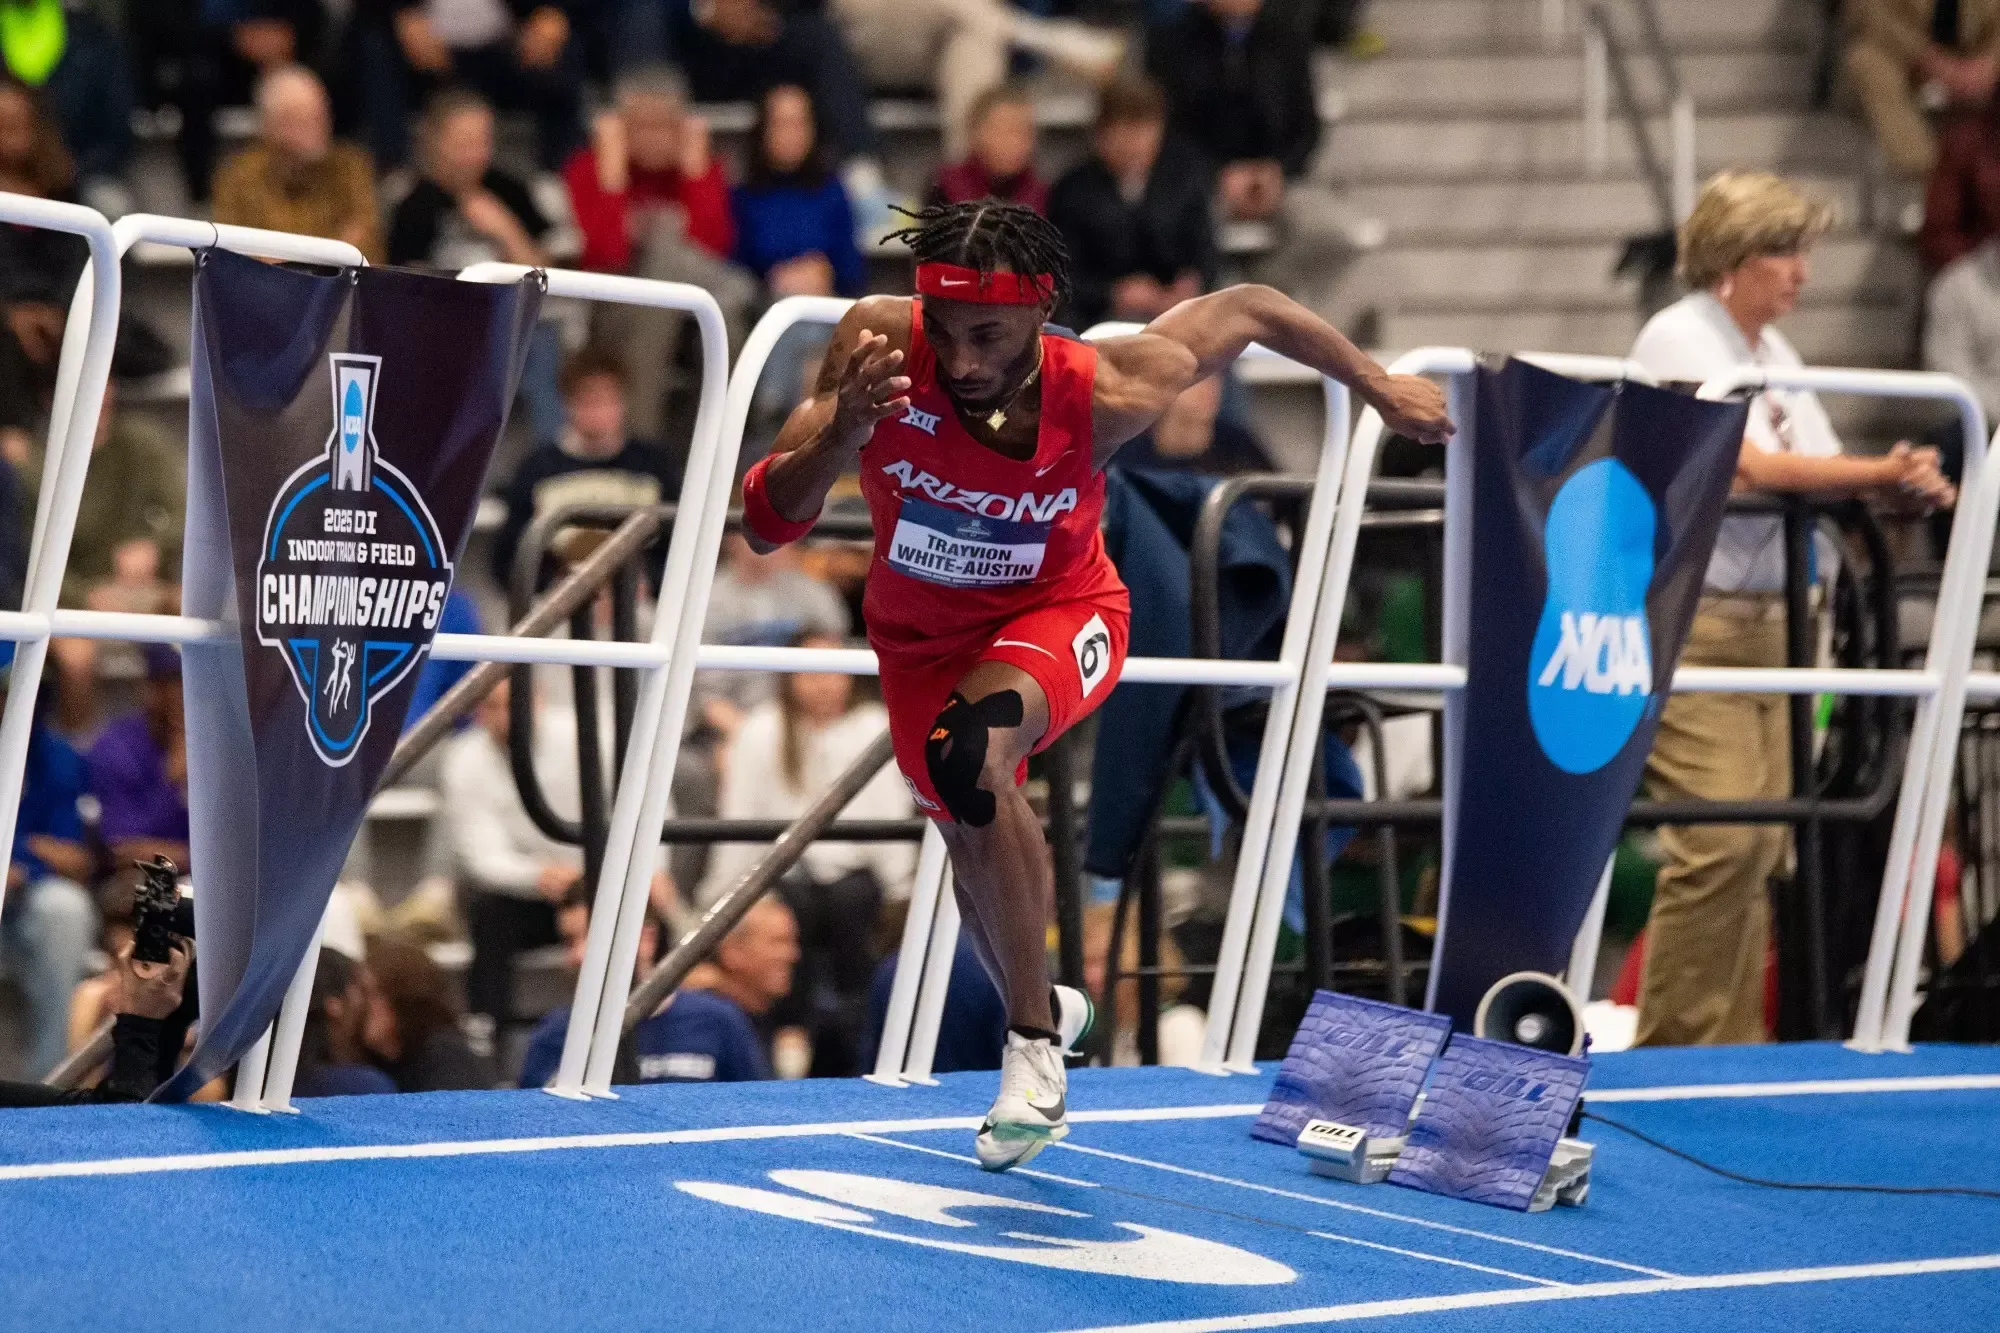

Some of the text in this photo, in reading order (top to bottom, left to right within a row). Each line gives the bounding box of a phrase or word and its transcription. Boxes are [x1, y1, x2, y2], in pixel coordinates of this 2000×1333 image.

[881, 459, 1078, 523] ARIZONA
[324, 508, 377, 535] 2025 DI
[287, 540, 416, 566] INDOOR TRACK & FIELD
[897, 544, 1035, 577] WHITE-AUSTIN
[927, 534, 1012, 562] TRAYVION
[263, 574, 446, 630] CHAMPIONSHIPS
[1081, 632, 1108, 679] 6
